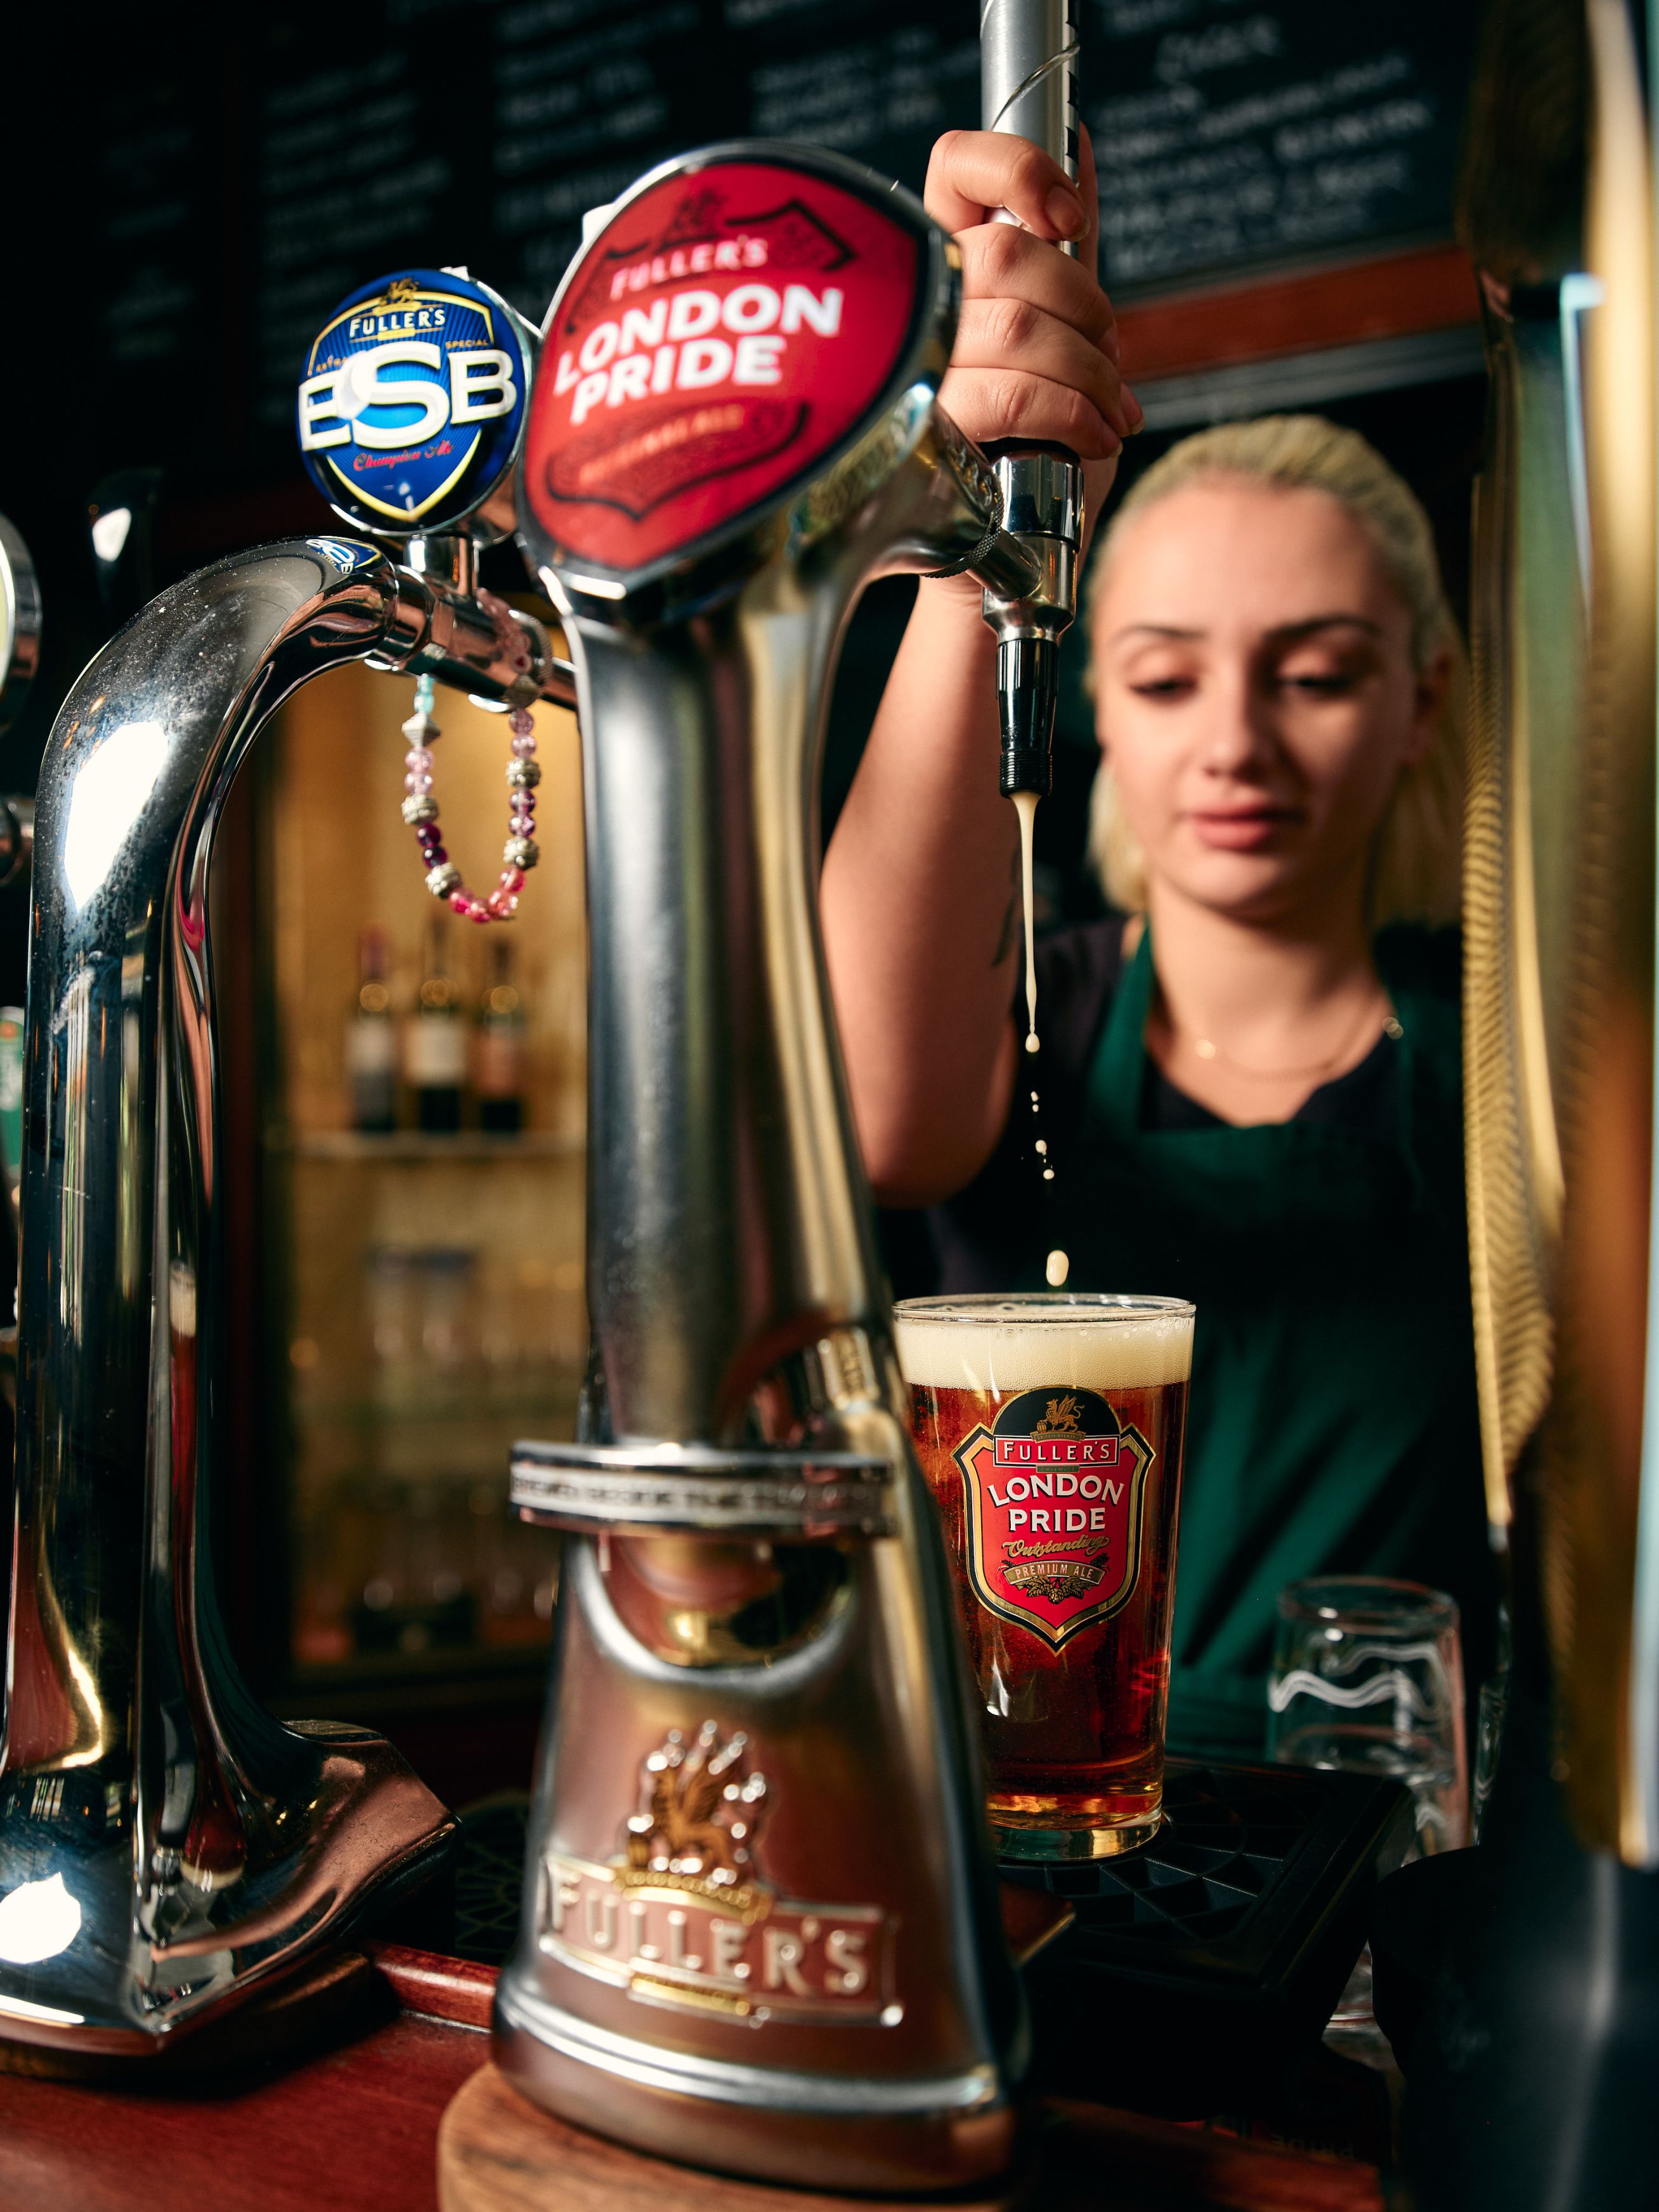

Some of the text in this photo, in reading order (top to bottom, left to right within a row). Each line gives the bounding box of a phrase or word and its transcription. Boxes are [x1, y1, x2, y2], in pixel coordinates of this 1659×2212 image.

[349, 308, 446, 338] FULLER'S
[445, 339, 488, 349] SPECIAL
[554, 283, 844, 396] LONDON
[570, 335, 786, 425] PRIDE
[298, 341, 517, 451] ESB
[1003, 1441, 1111, 1462] FULLER'S
[987, 1473, 1125, 1507] LONDON
[1009, 1507, 1106, 1533] PRIDE
[1002, 1534, 1110, 1558] Outstanding
[1015, 1564, 1094, 1579] PREMIUM ALE
[548, 1863, 869, 1996] FULLER'S
